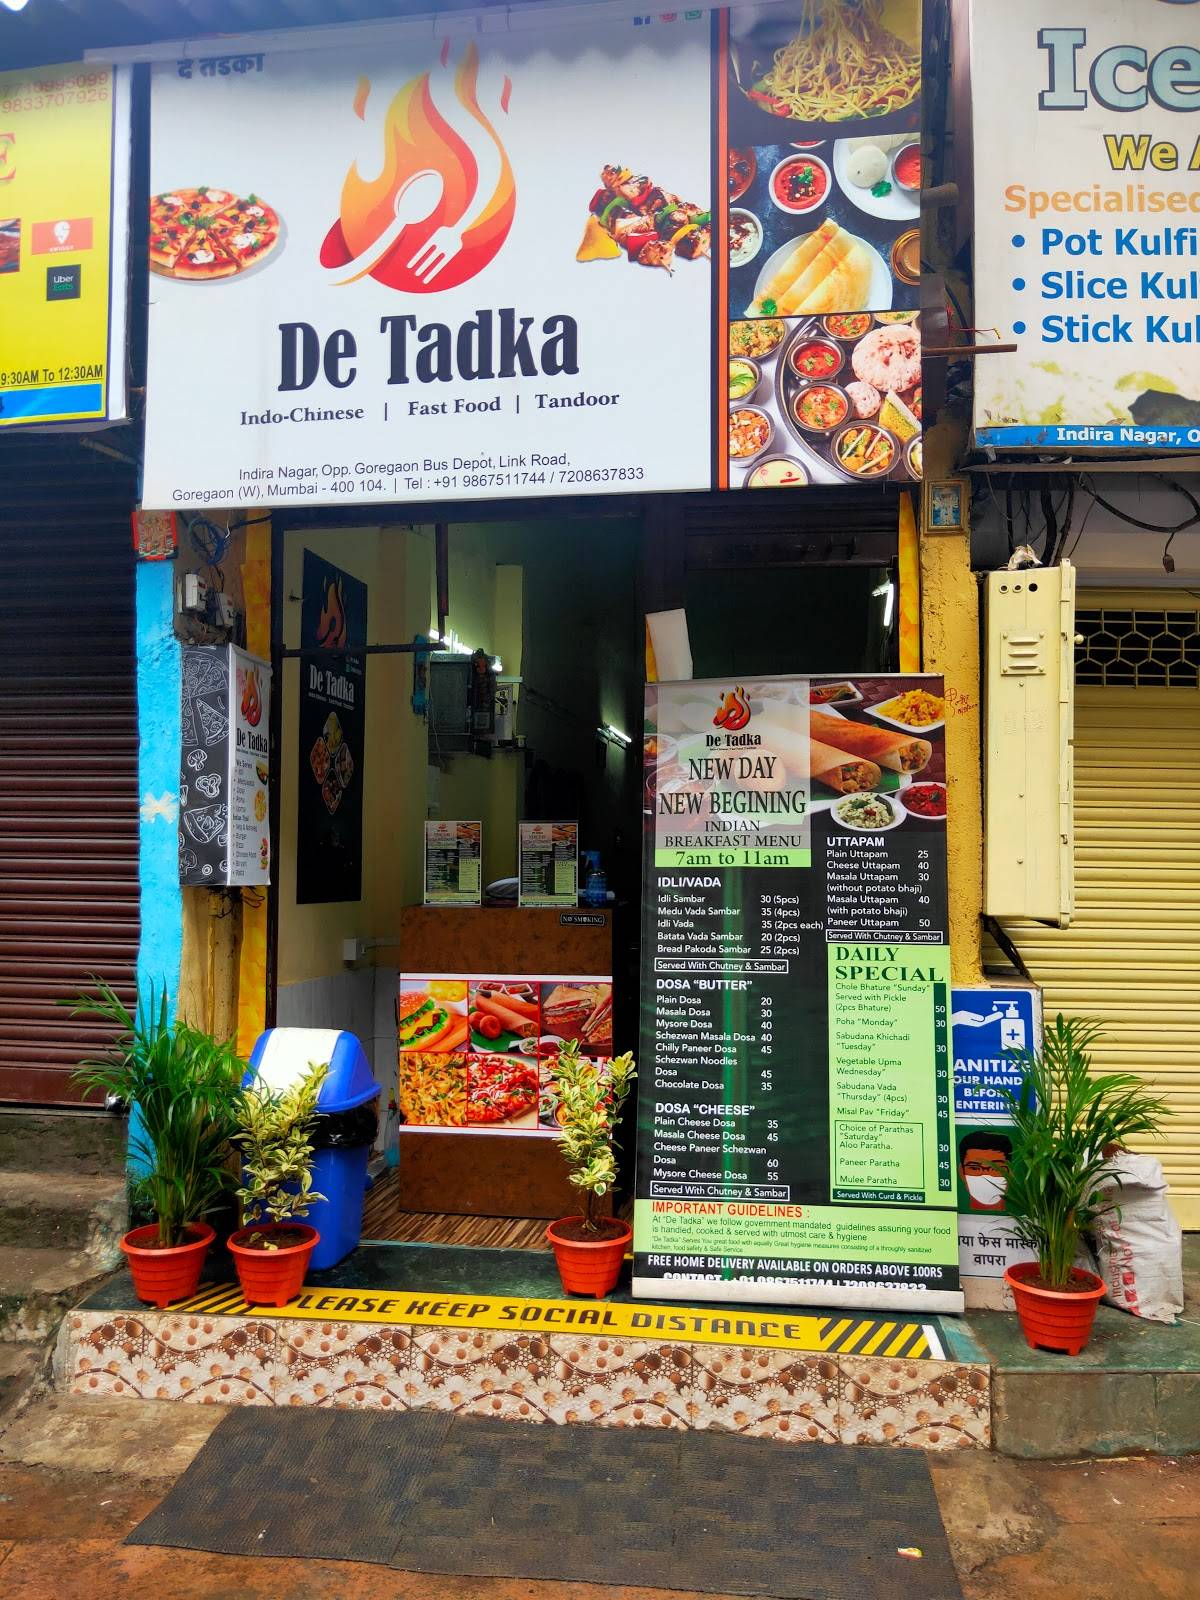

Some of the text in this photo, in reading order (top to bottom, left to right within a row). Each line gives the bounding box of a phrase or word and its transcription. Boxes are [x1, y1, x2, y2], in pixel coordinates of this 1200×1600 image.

[1037, 27, 1200, 112] Ice
[1103, 134, 1178, 171] We
[1041, 227, 1197, 256] Pot Kulfi
[53, 275, 74, 284] Uber
[1041, 271, 1200, 299] Slice Kul
[1041, 314, 1133, 343] Stick
[278, 307, 580, 391] De Tadka
[43, 369, 55, 382] To
[58, 364, 103, 381] 12:30AM
[239, 391, 621, 427] Indo-Chinese Fast Food Tandoor
[1057, 427, 1114, 441] Indira
[1120, 428, 1182, 445] Nagar,
[239, 453, 570, 480] Indira Nagar, Opp. Goregaon Bus Depot, Link Road,
[172, 489, 234, 502] Goregaon
[238, 485, 264, 500] (W),
[267, 482, 317, 496] Mumbai
[330, 480, 355, 493] 400
[360, 479, 386, 492] 104.
[404, 478, 422, 489] Tel
[434, 476, 456, 488] +91
[463, 472, 546, 487] 9867511744
[559, 467, 644, 483] 7208637833
[309, 664, 323, 692] De
[326, 670, 355, 703] Tadka
[237, 728, 268, 753] De Tadka
[706, 733, 761, 747] De Tadka
[688, 756, 777, 780] NEW DAY
[659, 790, 806, 815] NEW BEGINING
[705, 820, 760, 832] INDIAN
[665, 835, 801, 847] BREAKFAST MENU
[827, 837, 884, 846] UTTAPAM
[676, 850, 789, 865] 7am to 11am
[827, 849, 928, 860] Plain Uttapam 25
[827, 861, 929, 871] Cheese Uttapam 40
[658, 877, 721, 887] IDLI/VADA
[827, 872, 929, 883] Masala Uttapam 30
[827, 883, 922, 894] (without potato bhaji)
[658, 894, 799, 905] Idli Sambar 30 (5pcs)
[658, 907, 800, 918] Medu Vada Sambar 35 (4pcs)
[658, 919, 823, 931] Idli Vada 35 (2pcs each)
[828, 917, 930, 929] Paneer Uttapam 50
[836, 947, 899, 961] DAILY
[657, 961, 786, 972] Served With Chutney & Sambar
[835, 966, 944, 982] SPECIAL
[657, 995, 772, 1005] Plain Dosa 20
[656, 1007, 772, 1018] Masala Dosa 30
[656, 1019, 772, 1030] Mysore Dosa 40
[935, 1018, 947, 1028] 30
[954, 1059, 1031, 1073] ANITIZE
[953, 1075, 980, 1084] OUR
[654, 1116, 778, 1129] Plain Cheese Dosa 35
[652, 1201, 802, 1218] IMPORTANT GUIDELINES
[978, 1232, 1002, 1249] फेस
[648, 1255, 942, 1278] FREE HOME DELIVERY AVAILABLE ON ORDERS ABOVE 100RS
[973, 1254, 1007, 1266] वापरा
[297, 1294, 801, 1341] LEASE KEEP SOCIAL DISTANCE
